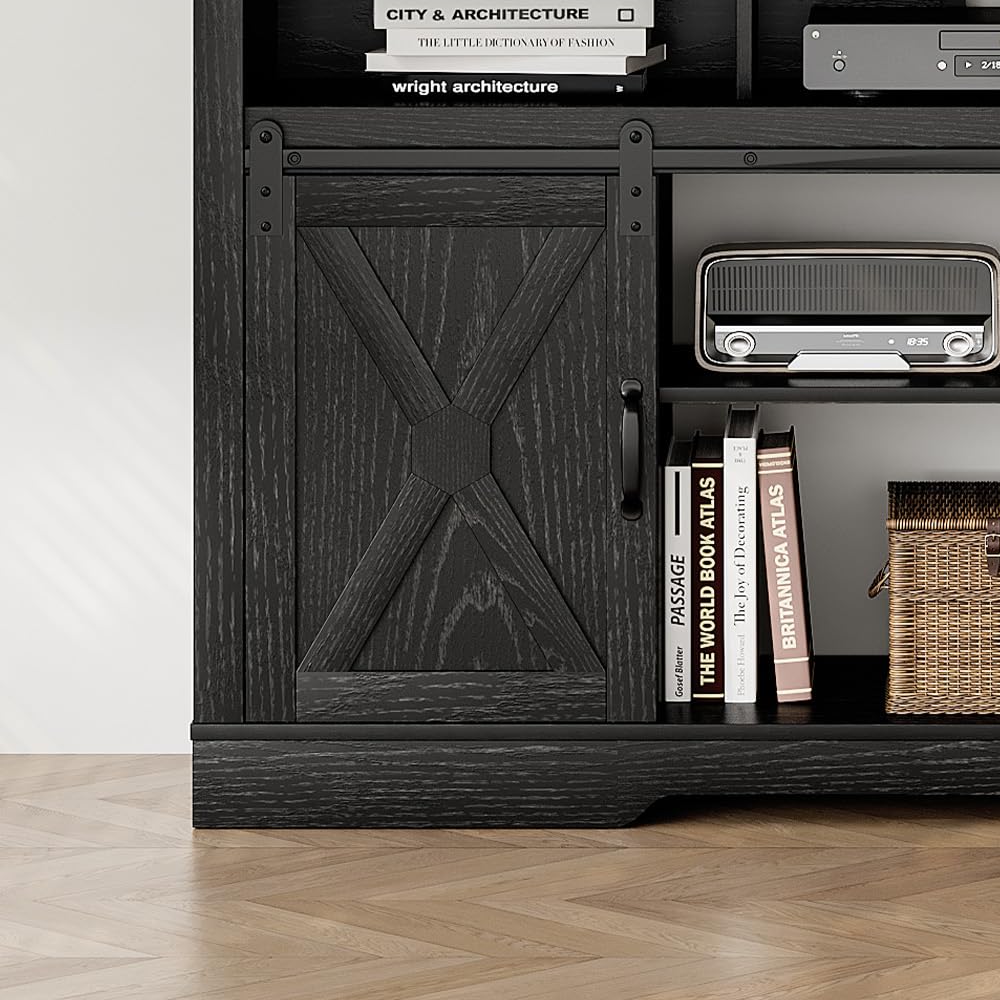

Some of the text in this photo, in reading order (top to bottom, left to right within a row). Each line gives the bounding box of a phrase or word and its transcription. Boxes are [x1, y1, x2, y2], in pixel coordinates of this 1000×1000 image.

[386, 8, 589, 21] CITY & ARCHITECTURE
[417, 37, 616, 48] THE LITTLE DICTIONARY OF FASHION
[392, 80, 559, 95] wright architecture
[769, 484, 787, 538] ATLAS
[699, 476, 716, 686] THE WORLD BOOK ATLAS
[734, 486, 750, 627] The Joy of Decorating
[670, 554, 686, 626] PASSAGE
[775, 541, 797, 651] BRITANNICA
[675, 646, 684, 697] Gosef Blatter
[737, 634, 746, 667] Howard
